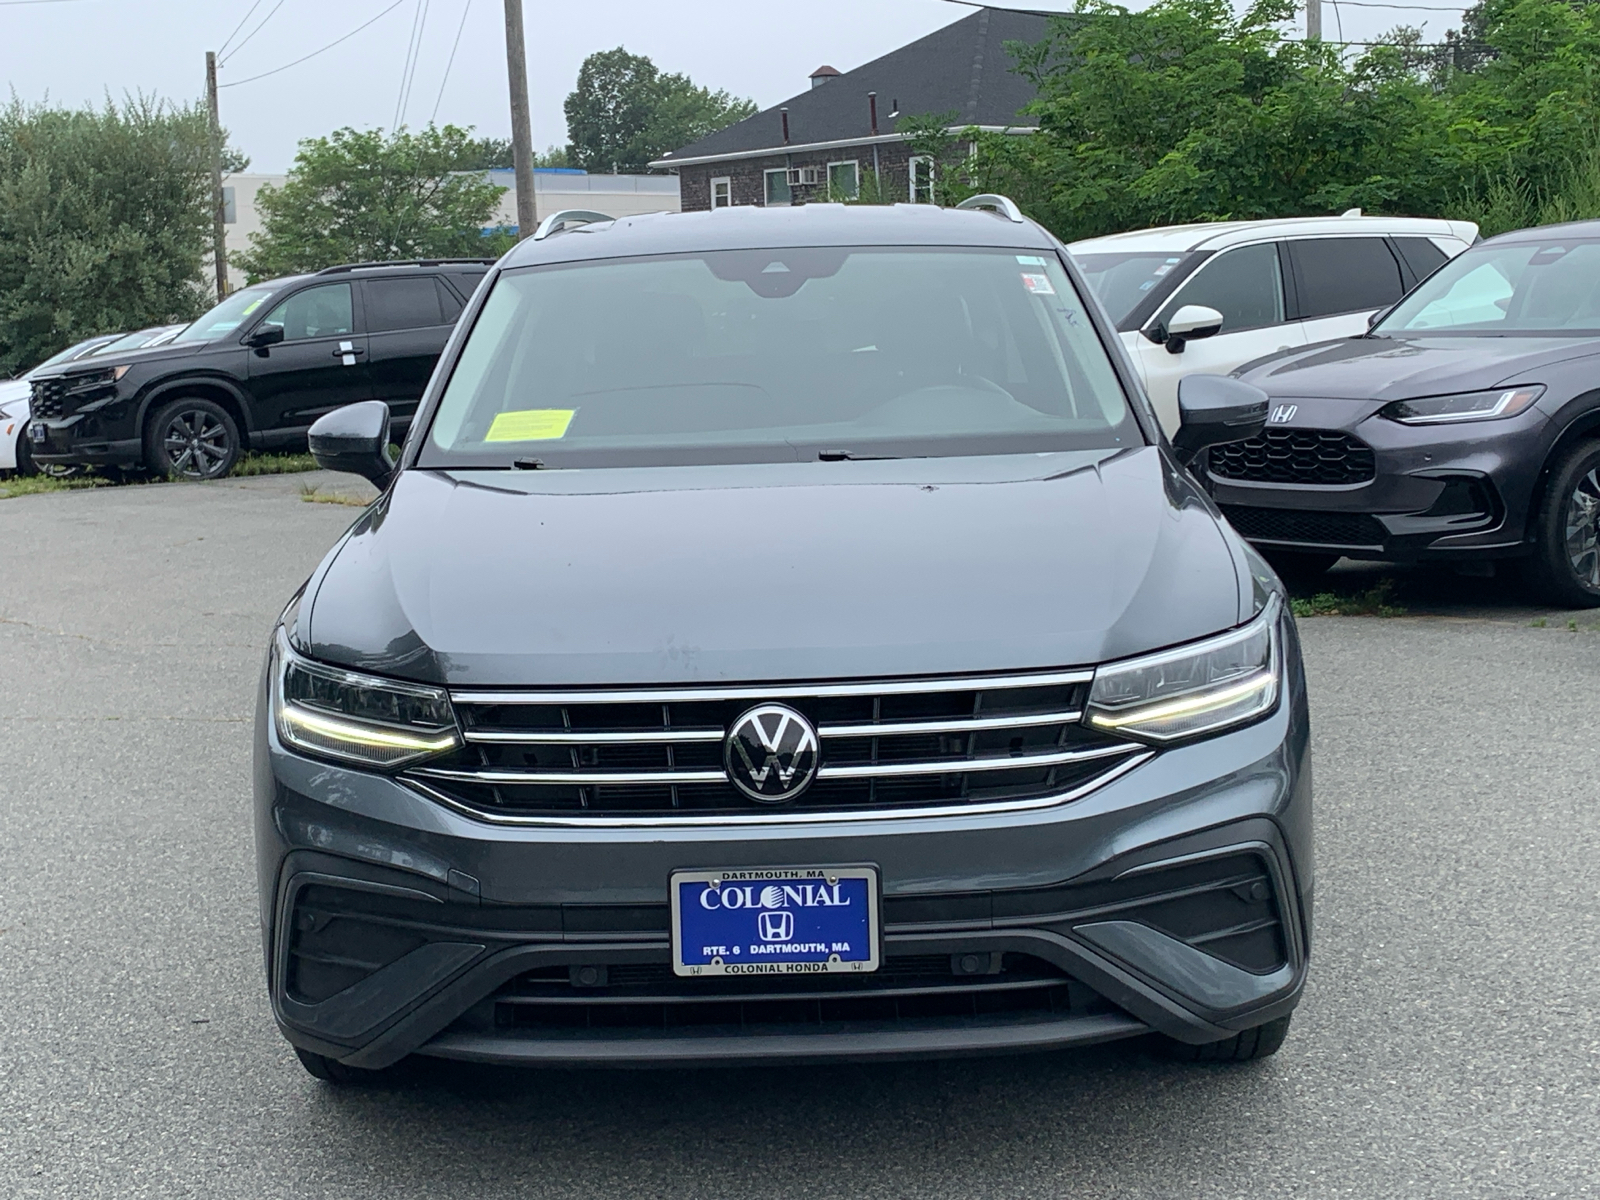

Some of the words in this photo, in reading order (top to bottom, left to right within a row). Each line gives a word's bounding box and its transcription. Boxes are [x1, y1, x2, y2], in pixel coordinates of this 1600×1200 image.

[722, 870, 803, 880] DARTMOUTH,
[807, 870, 825, 878] MA
[699, 884, 851, 910] COLONIAL
[703, 946, 730, 956] RTE.
[732, 945, 741, 955] 6
[750, 943, 829, 954] DARTMOUTH,
[832, 942, 850, 952] MA
[724, 964, 783, 974] COLONIAL
[786, 963, 829, 973] HONDA
